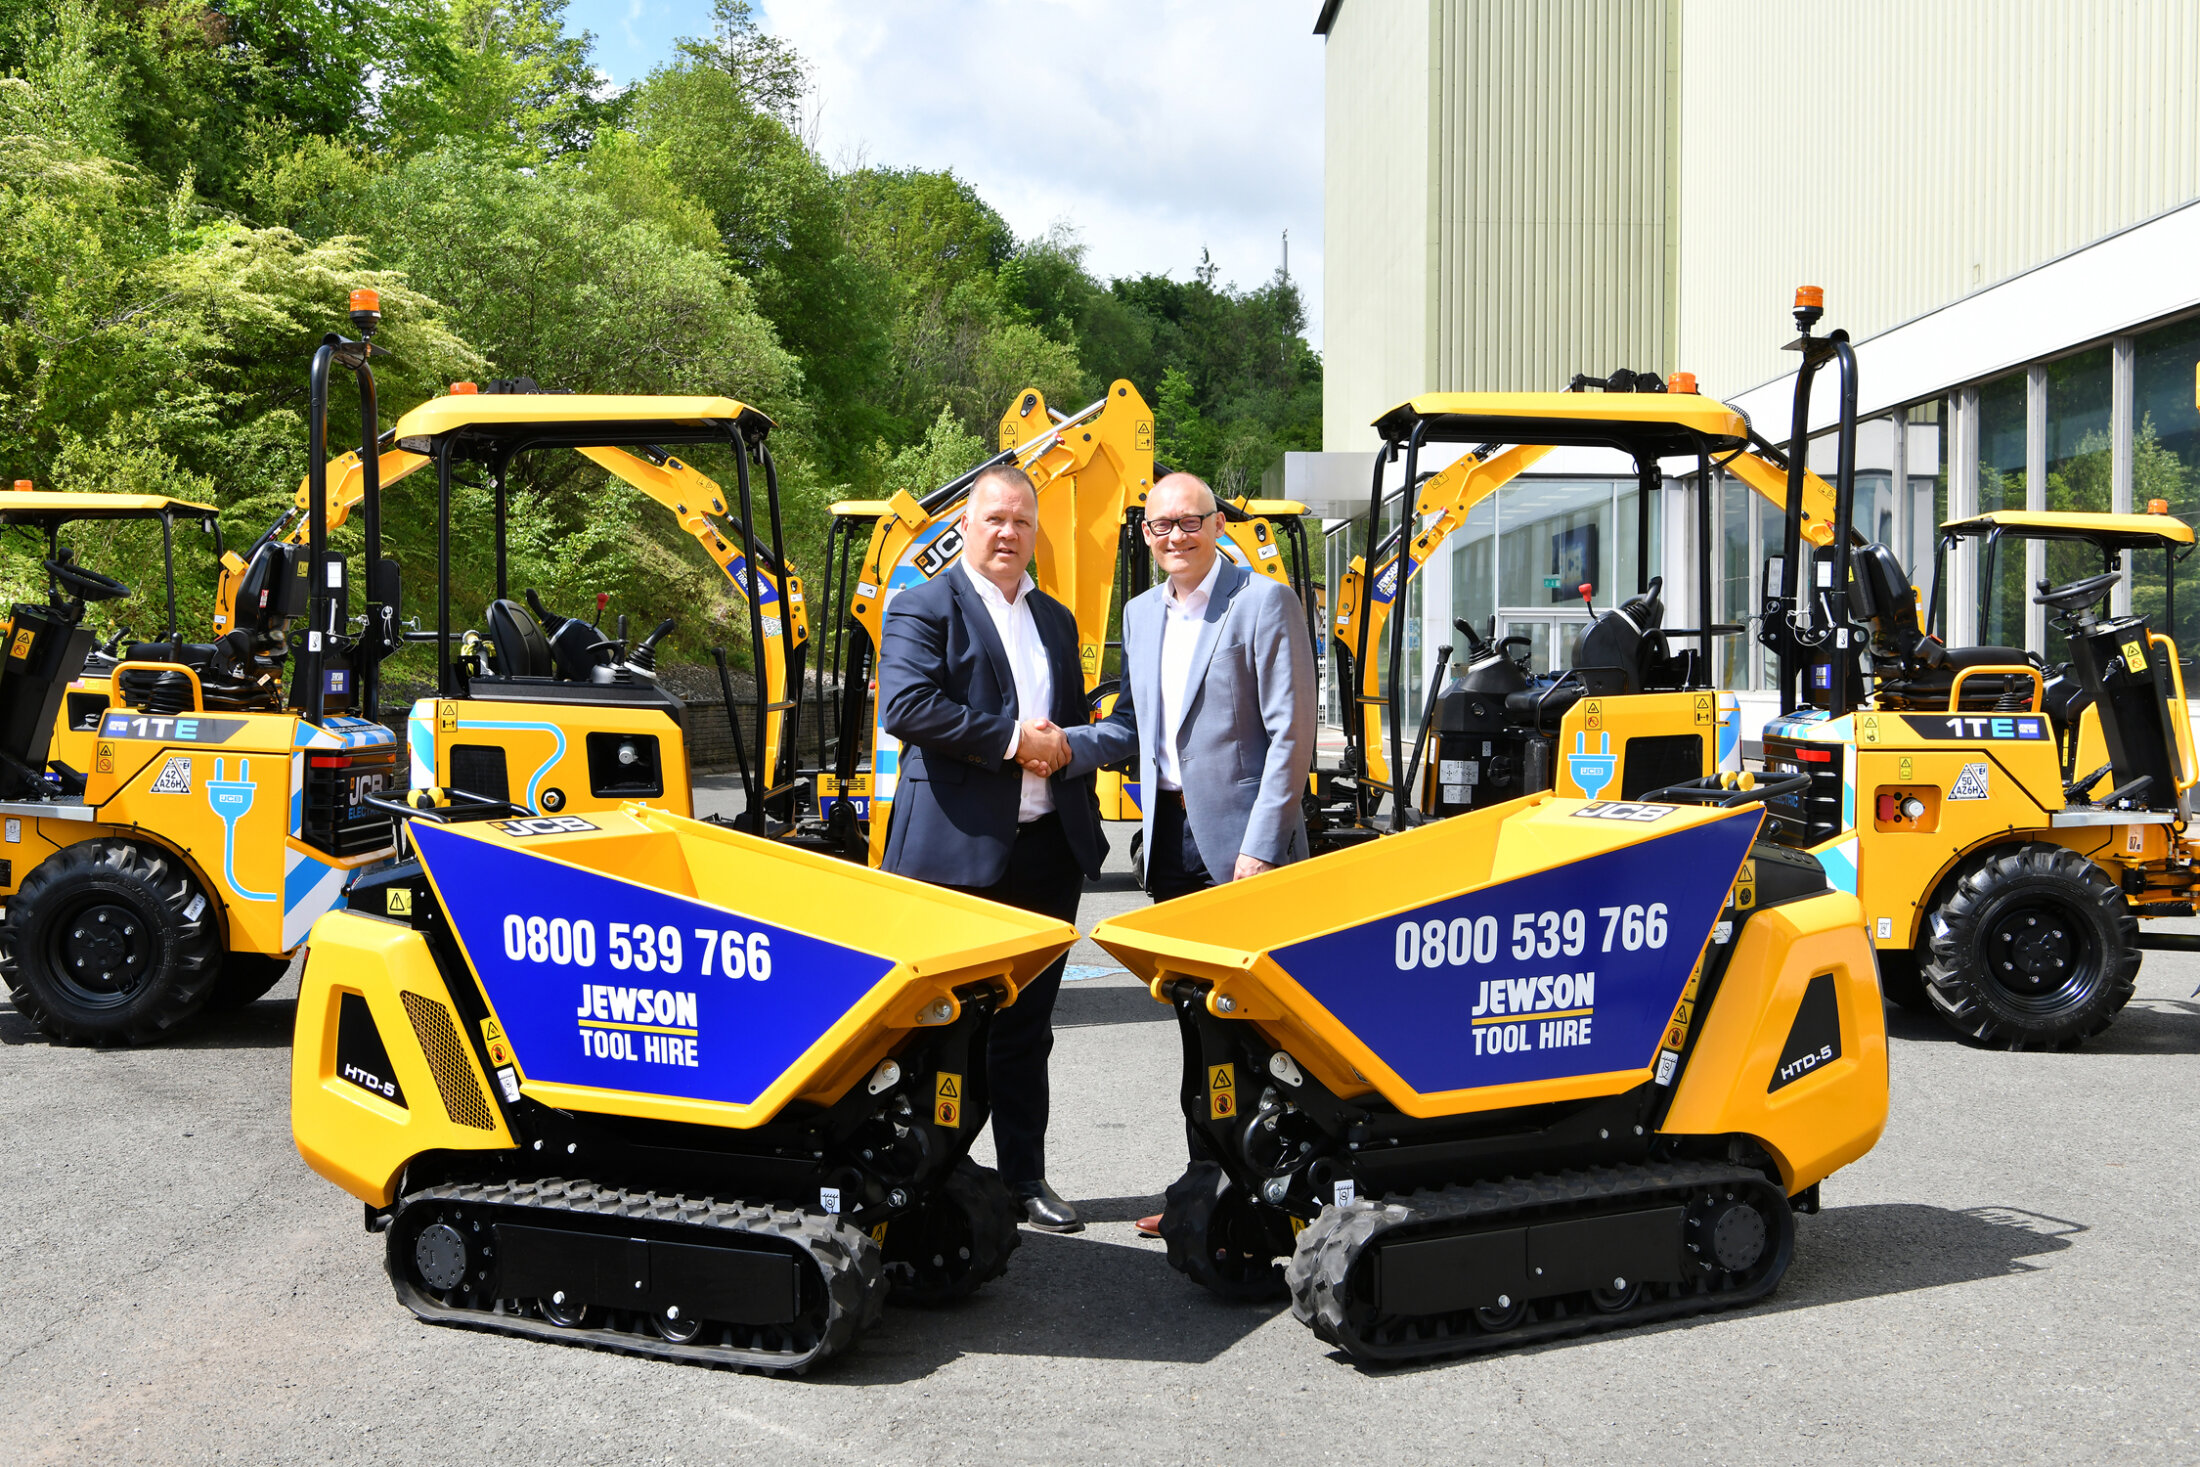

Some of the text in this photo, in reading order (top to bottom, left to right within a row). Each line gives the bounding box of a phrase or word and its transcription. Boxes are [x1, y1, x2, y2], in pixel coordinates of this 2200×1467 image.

[924, 519, 963, 574] JC
[132, 717, 199, 740] 1TE
[1946, 717, 2015, 738] 1TE
[159, 779, 182, 788] AZ6H
[165, 770, 176, 779] 42
[1581, 767, 1603, 775] JCB
[220, 795, 242, 803] JCB
[1956, 785, 1979, 795] AZ6H
[504, 817, 596, 836] JCB
[1576, 803, 1674, 822] JCB
[503, 914, 772, 981] 0800 539 766
[1395, 902, 1668, 971] 0800 539 766
[577, 984, 698, 1028] JEWSON
[1471, 971, 1595, 1017] JEWSON
[579, 1029, 699, 1068] TOOL HIRE
[1472, 1017, 1592, 1056] TOOL HIRE
[1780, 1044, 1833, 1080] HTD-5
[344, 1063, 396, 1097] HTD-5
